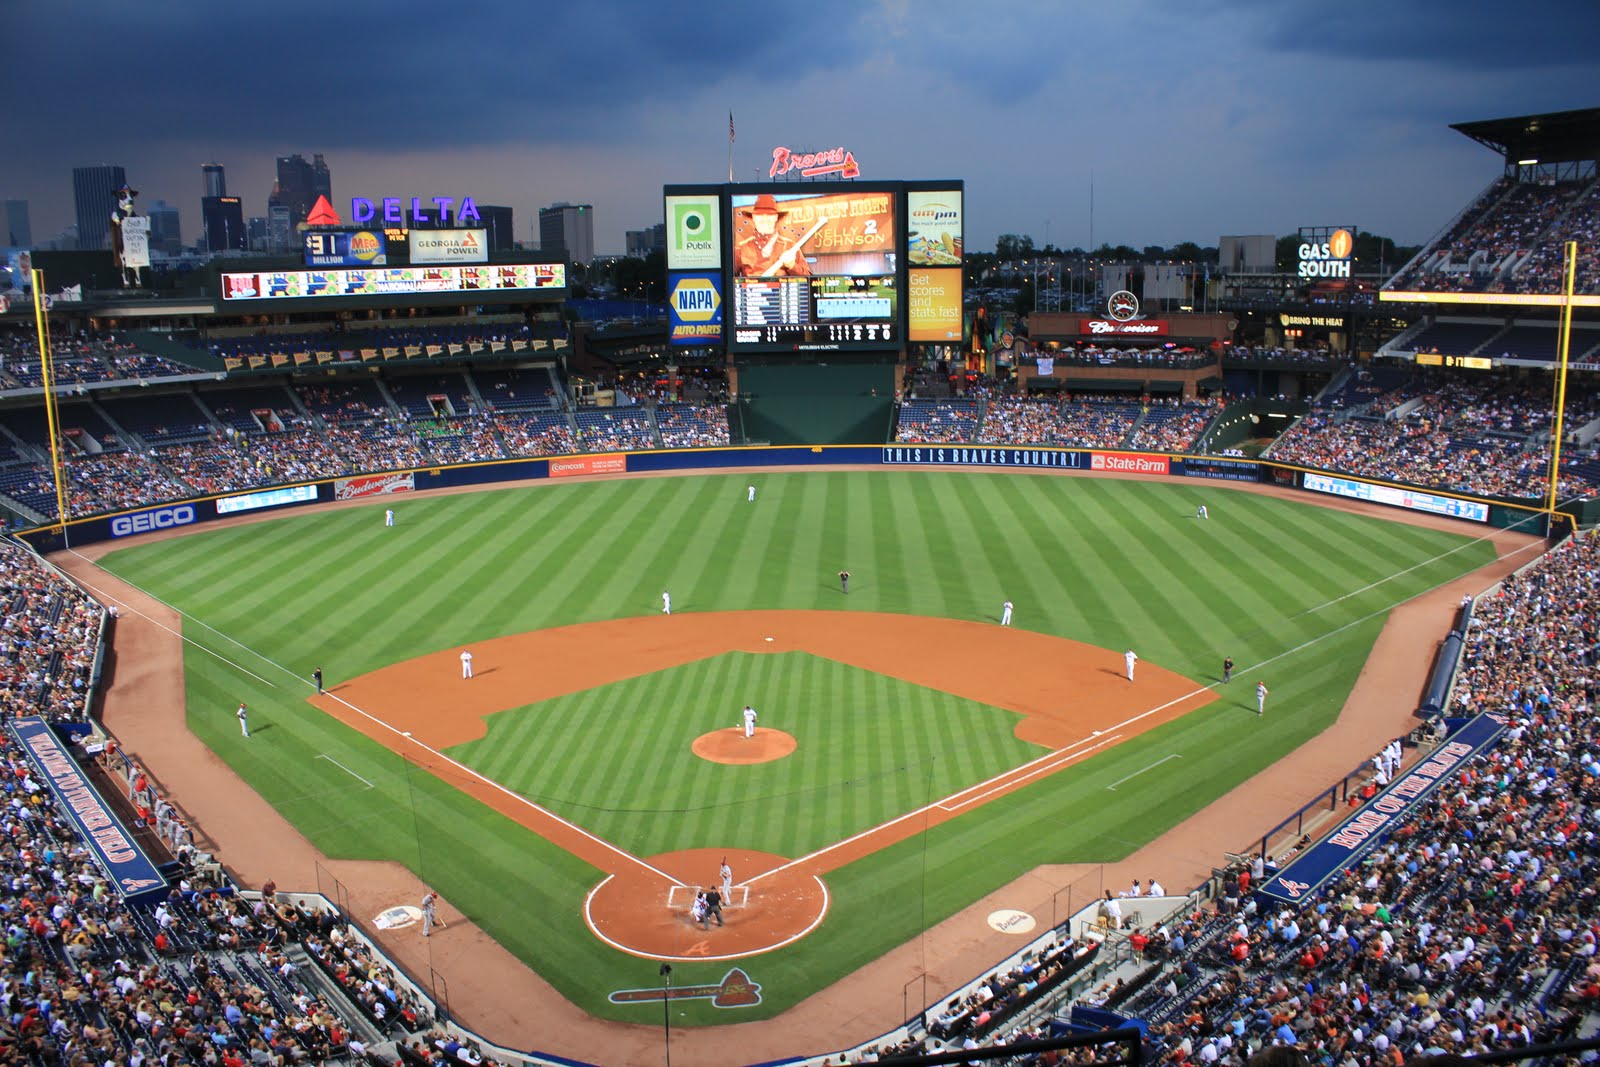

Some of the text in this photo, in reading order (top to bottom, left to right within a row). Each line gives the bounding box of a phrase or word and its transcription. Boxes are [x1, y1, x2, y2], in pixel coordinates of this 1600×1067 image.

[769, 147, 843, 178] Braves
[352, 197, 480, 222] DELTA
[850, 196, 888, 217] NIGHT
[814, 226, 859, 239] KELLY
[352, 237, 379, 249] MEGA
[418, 240, 461, 248] GEORGIA
[686, 242, 713, 251] Publix
[815, 233, 885, 248] JOHNSON
[446, 247, 479, 255] POWER
[1298, 243, 1330, 260] GAS
[313, 256, 343, 264] MILLION
[1298, 260, 1351, 278] SOUTH
[910, 274, 929, 285] Get
[910, 286, 944, 296] scores
[679, 291, 713, 310] NAPA
[910, 297, 931, 306] and
[910, 307, 959, 318] stats fast
[1088, 321, 1159, 334] Budweiser
[1289, 316, 1344, 326] BRING THE HEAT
[673, 325, 722, 335] AUTO PARTS
[886, 448, 1077, 467] THIS IS BRAVES COUNTRY
[341, 474, 404, 498] Budweiser
[112, 506, 194, 536] GEICO
[26, 733, 137, 863] WELCOME TO TURNER FIELD
[1328, 742, 1473, 849] HOME OF THE BRAVES
